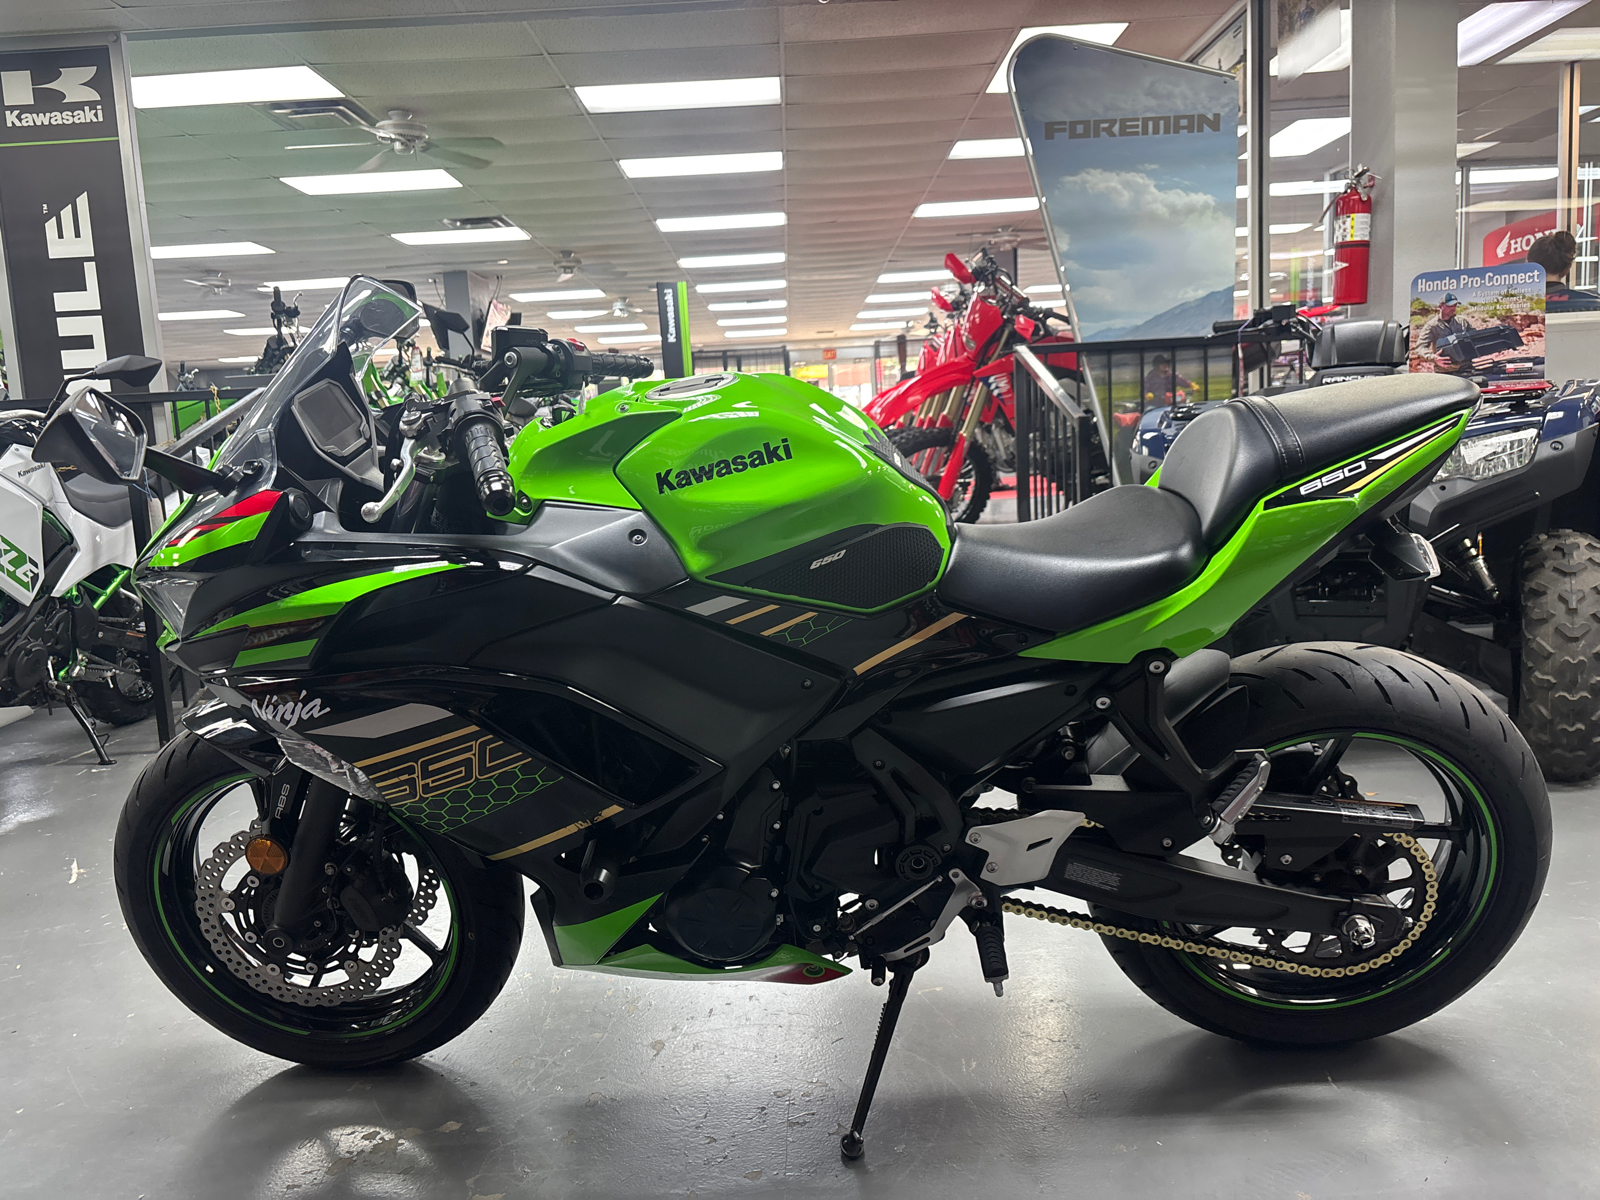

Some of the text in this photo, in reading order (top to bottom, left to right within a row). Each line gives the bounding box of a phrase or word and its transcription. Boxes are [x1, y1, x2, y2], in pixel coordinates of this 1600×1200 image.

[5, 105, 104, 127] Kawasaki
[1044, 113, 1221, 140] FOREMAN
[1417, 269, 1540, 293] Honda Pro-Connect
[1477, 289, 1500, 298] System
[656, 437, 793, 495] Kawasaki
[1299, 460, 1367, 496] 650
[809, 549, 847, 570] 650
[251, 690, 331, 731] Ninja
[274, 783, 290, 820] ABS
